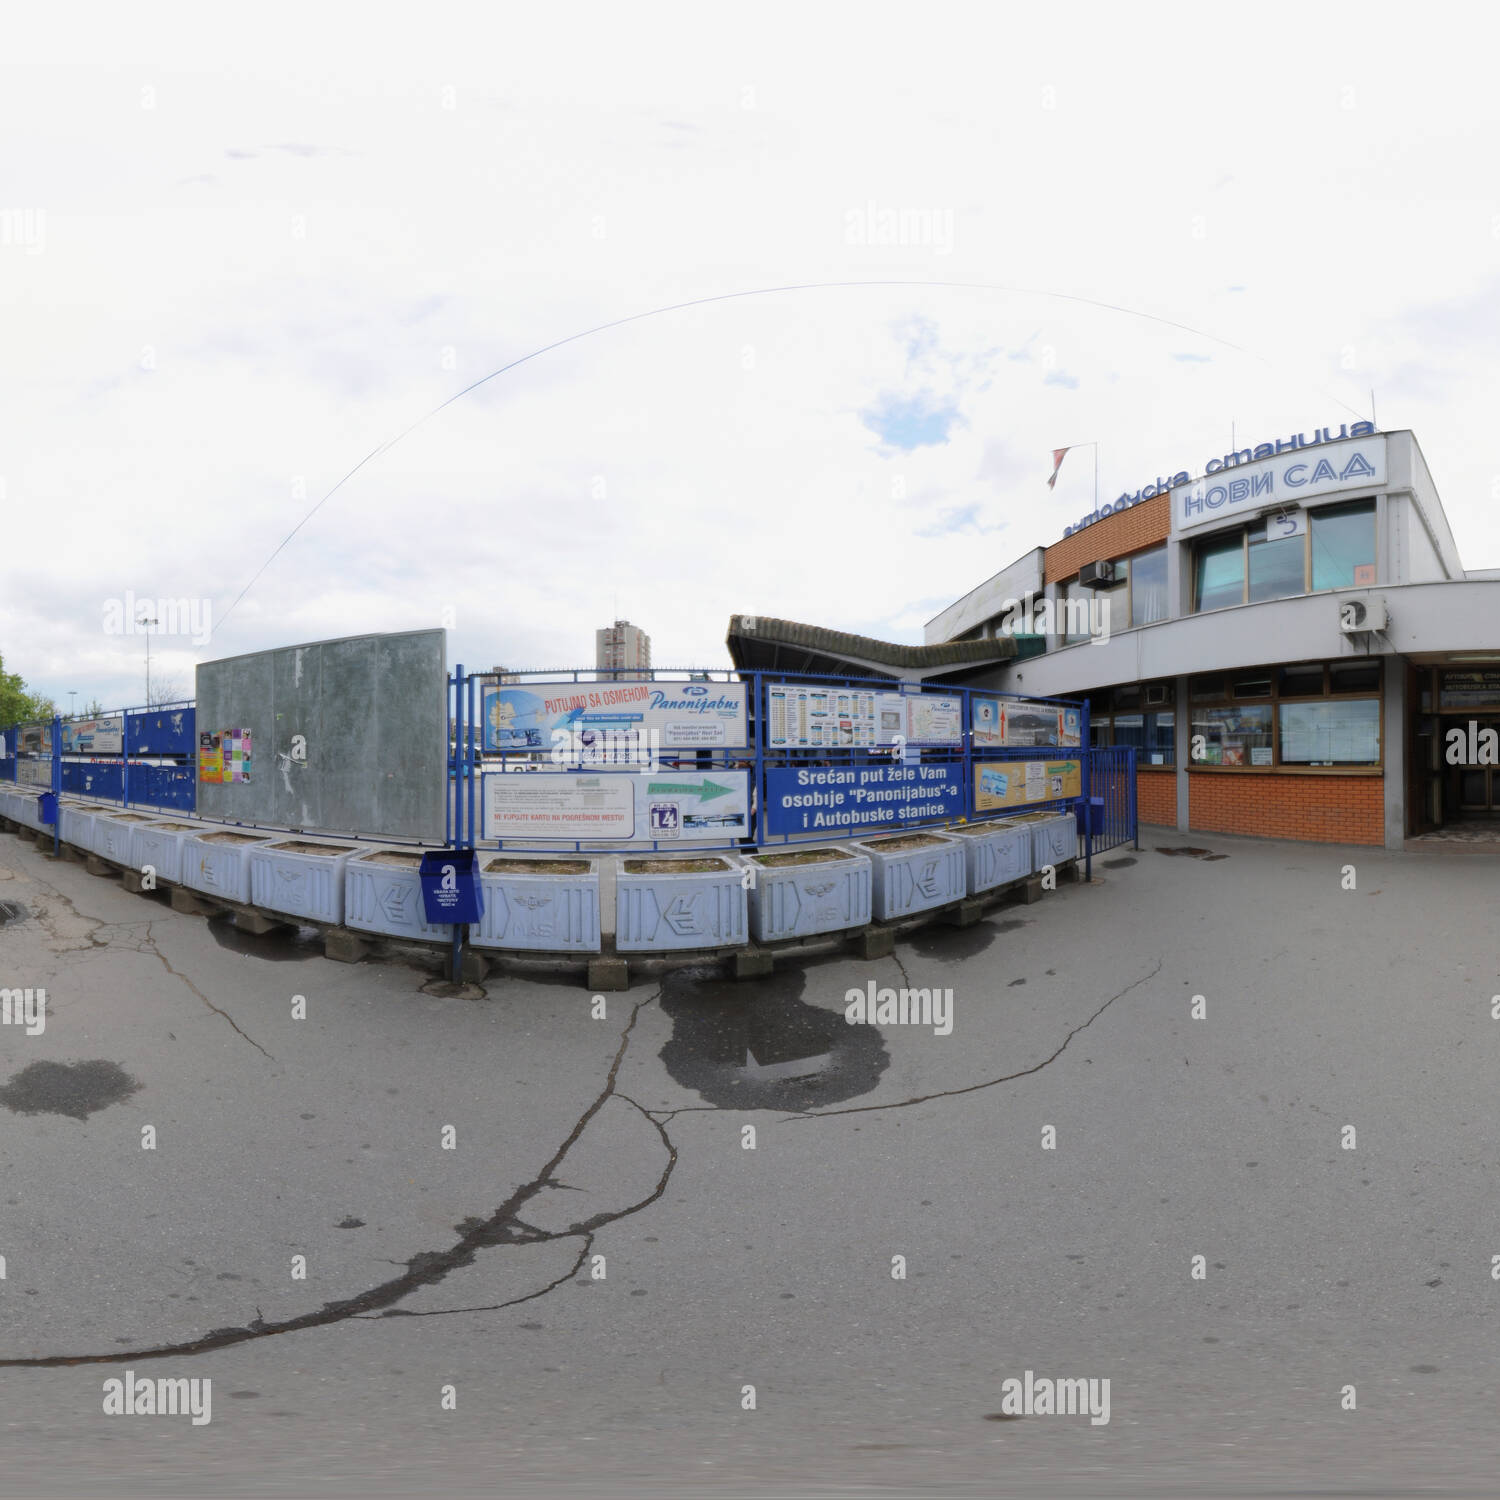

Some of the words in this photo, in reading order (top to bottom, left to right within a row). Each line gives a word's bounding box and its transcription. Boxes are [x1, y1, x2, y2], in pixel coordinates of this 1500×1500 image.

[1184, 471, 1274, 518] НОВИ
[1283, 452, 1376, 489] САД
[588, 693, 602, 708] SA
[602, 686, 650, 706] OSMEHOM
[649, 690, 740, 714] Panonijabus
[798, 768, 855, 786] Srećan
[860, 768, 884, 786] put
[887, 767, 916, 782] žele
[919, 767, 947, 781] Vam
[652, 810, 677, 828] 14
[803, 813, 808, 828] i
[813, 807, 894, 828] Autobuske
[898, 804, 944, 819] stanice
